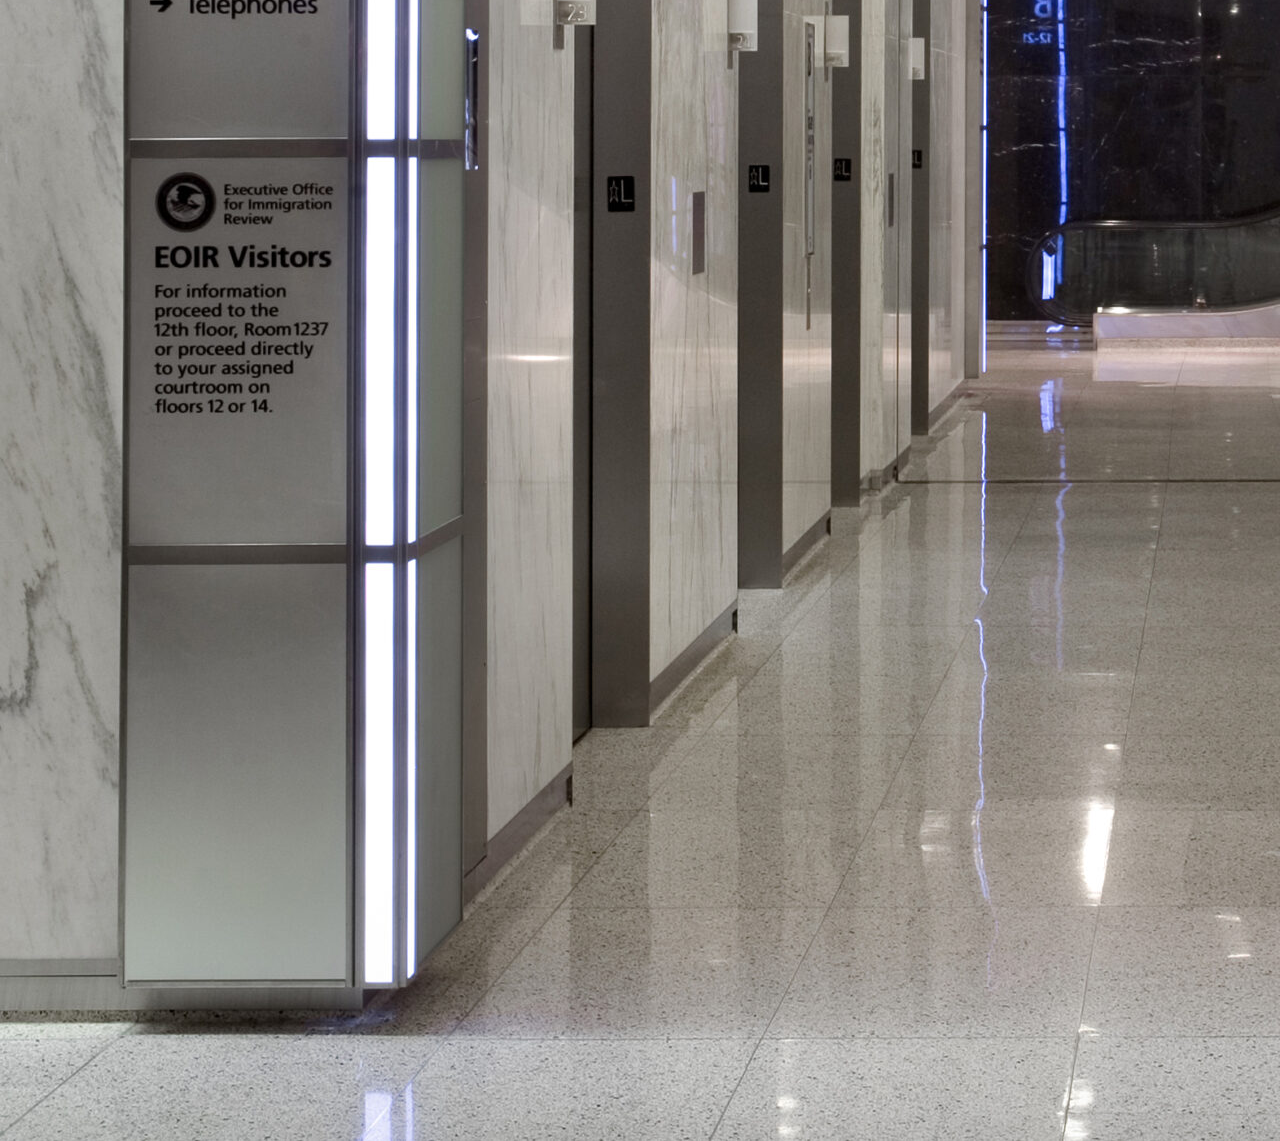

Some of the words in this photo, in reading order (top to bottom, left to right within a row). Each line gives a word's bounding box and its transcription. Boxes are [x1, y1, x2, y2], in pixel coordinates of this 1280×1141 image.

[759, 167, 768, 185] L
[223, 184, 289, 196] Executive
[292, 183, 334, 196] Office
[620, 179, 633, 203] L
[223, 198, 245, 211] for
[248, 198, 333, 213] Immigration
[223, 213, 274, 225] Review
[154, 246, 220, 269] EOIR
[227, 245, 332, 269] Visitors
[154, 285, 182, 299] For
[186, 283, 287, 299] information
[154, 303, 222, 322] proceed
[227, 305, 246, 318] to
[250, 303, 279, 318] the
[154, 323, 189, 337] 12th
[193, 322, 238, 339] floor,
[244, 323, 292, 337] Room
[293, 322, 329, 337] 1237
[154, 346, 174, 357] or
[178, 341, 246, 360] proceed
[250, 341, 314, 360] directly
[154, 363, 173, 376] to
[177, 365, 217, 379] your
[221, 360, 294, 379] assigned
[154, 382, 243, 395] courtroom
[247, 383, 271, 394] on
[154, 399, 204, 414] floors
[207, 399, 224, 414] 12
[227, 403, 247, 414] or
[251, 399, 273, 413] 14.
